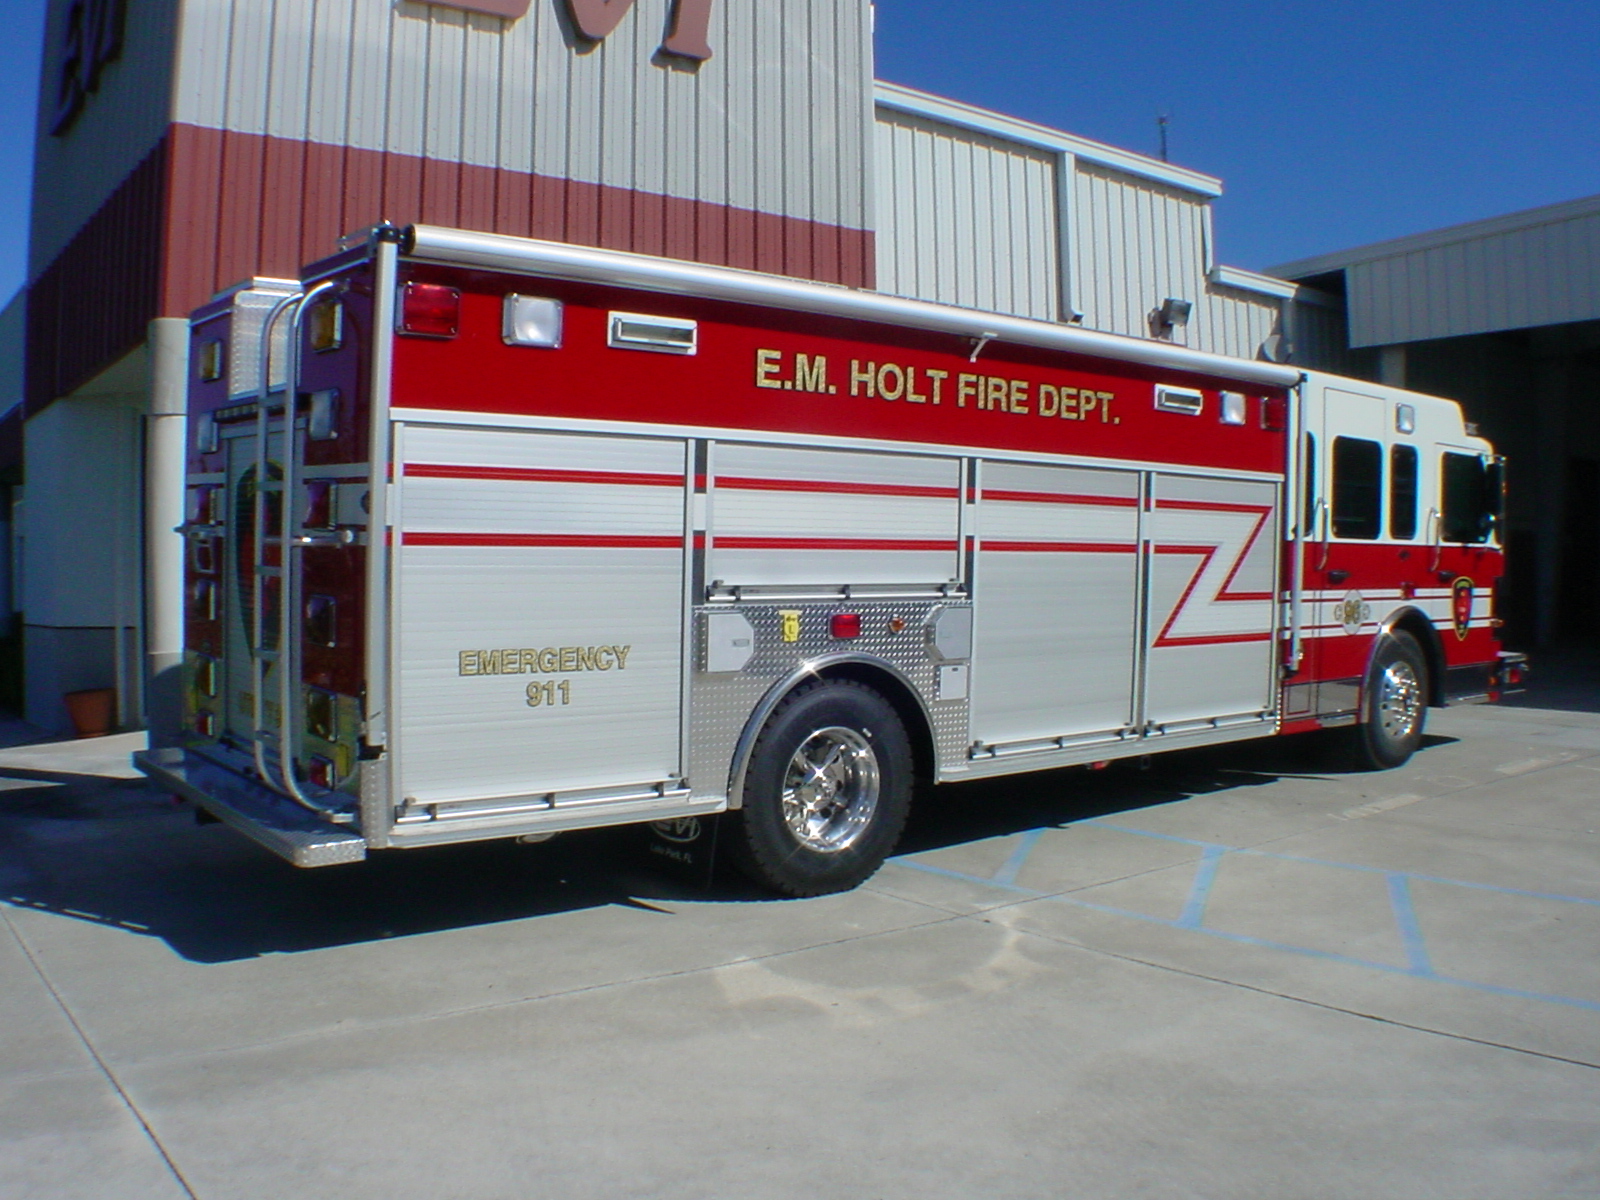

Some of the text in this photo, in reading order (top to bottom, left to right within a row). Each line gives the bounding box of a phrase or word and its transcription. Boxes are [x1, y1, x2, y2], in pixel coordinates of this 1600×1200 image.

[756, 348, 1121, 426] E.M. HOLT FIRE DEPT.
[459, 645, 631, 677] EMERGENCY
[526, 679, 571, 708] 911
